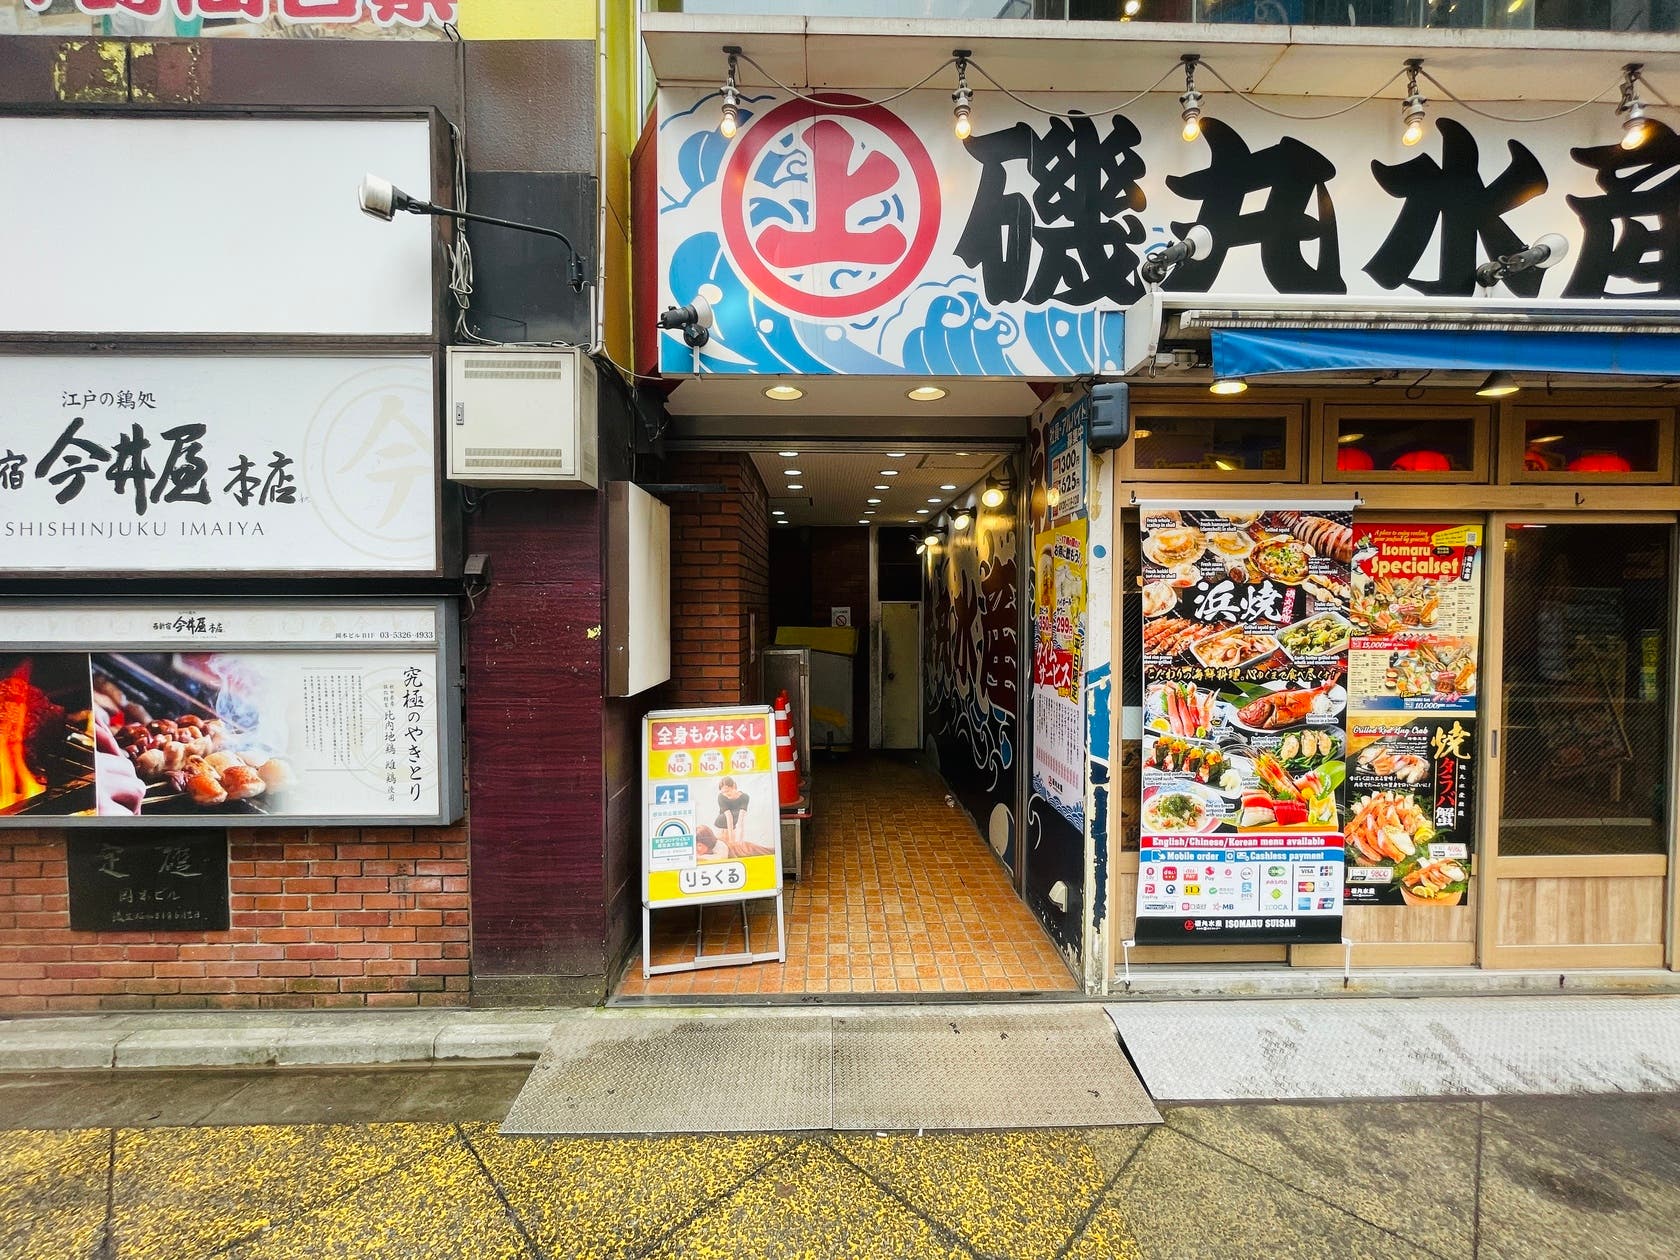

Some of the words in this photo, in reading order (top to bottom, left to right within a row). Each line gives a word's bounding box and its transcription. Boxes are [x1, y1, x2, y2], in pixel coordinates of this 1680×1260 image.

[61, 389, 158, 411] 江戸の鶏処
[36, 416, 213, 517] 今井屋
[223, 451, 298, 507] 本店
[4, 520, 168, 539] SHISHINJUKU
[181, 520, 266, 537] IMAIYA
[1382, 543, 1431, 556] Isomaru
[1194, 579, 1283, 623] 浜焼
[379, 631, 434, 640] 03-5326-4933
[1036, 641, 1058, 668] タイム
[1038, 659, 1071, 691] サービス
[402, 666, 424, 803] 究極のやきとり
[657, 723, 763, 747] 全身もみほぐし
[1430, 720, 1472, 760] 焼
[659, 787, 686, 804] 4F
[1152, 836, 1258, 848] English/Chinese/Korean
[1260, 837, 1284, 847] menu
[1285, 836, 1325, 847] available
[1166, 851, 1195, 861] Mobile
[1196, 852, 1219, 861] order
[1249, 851, 1287, 861] Cashless
[685, 868, 740, 888] りらくる
[1225, 919, 1263, 928] ISOMARU
[1264, 919, 1297, 928] SUISAN
